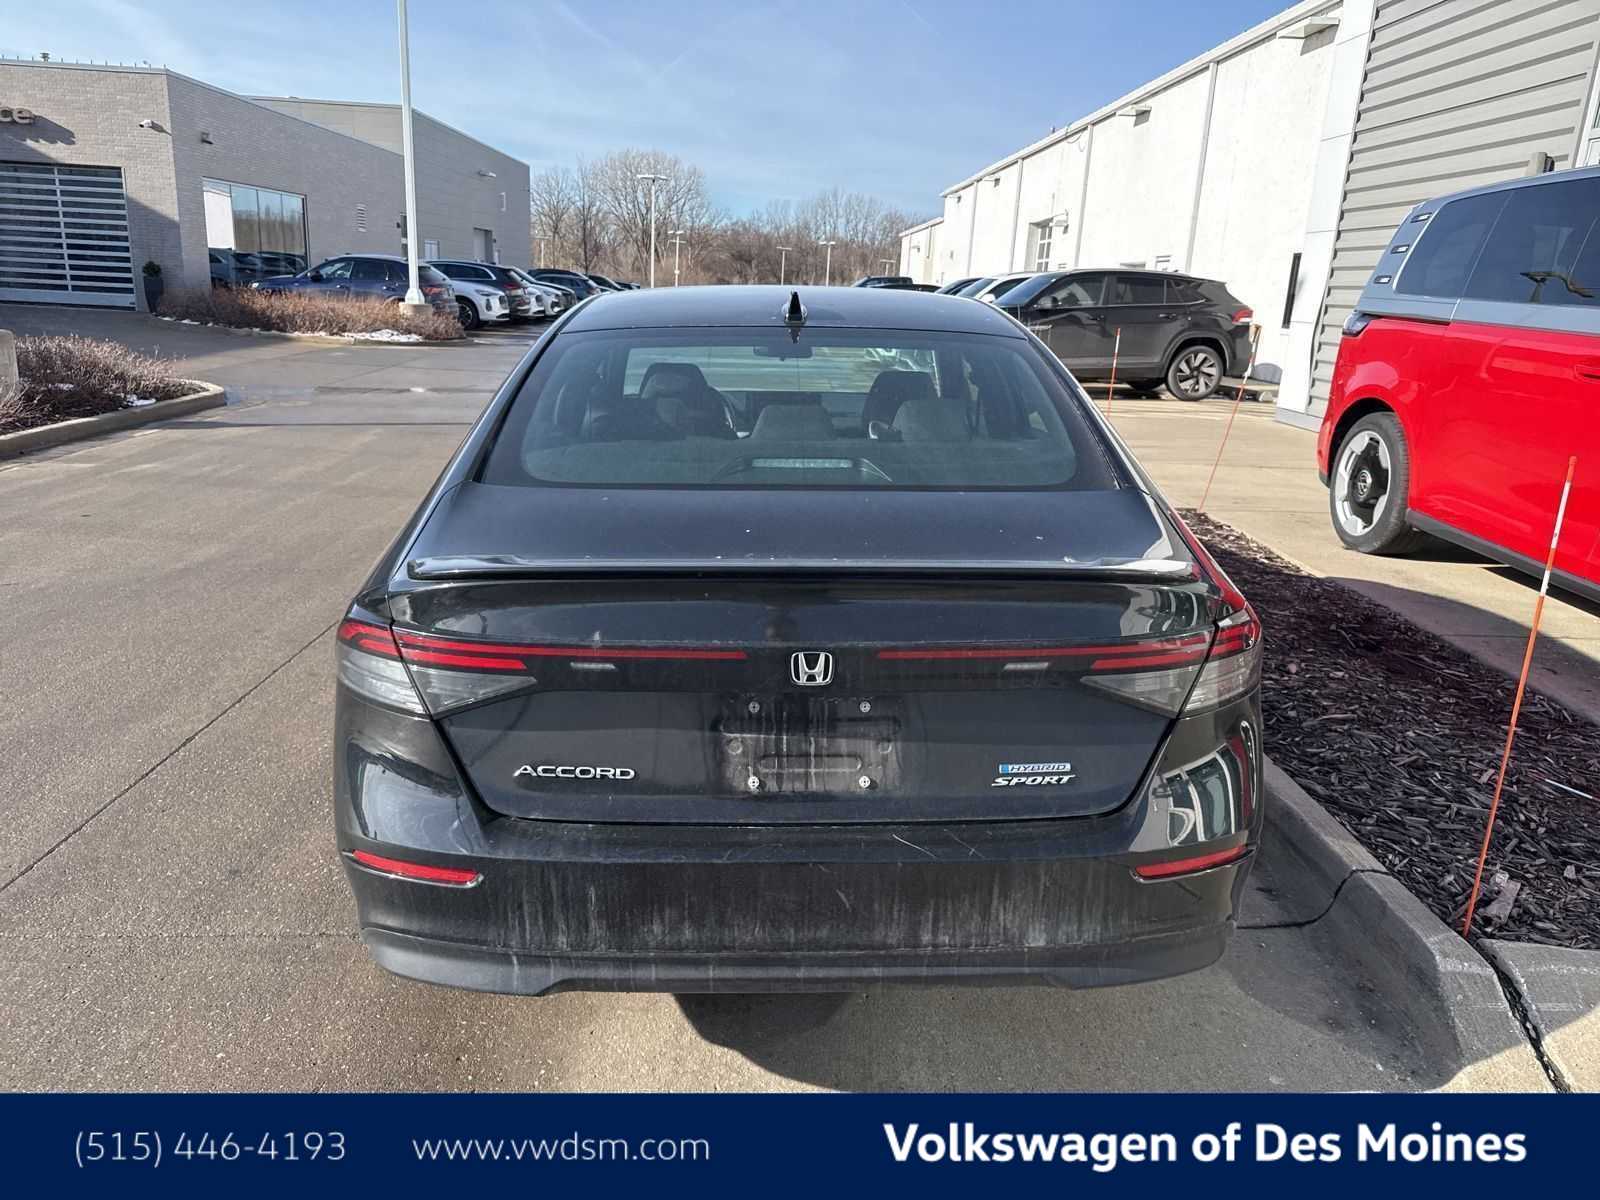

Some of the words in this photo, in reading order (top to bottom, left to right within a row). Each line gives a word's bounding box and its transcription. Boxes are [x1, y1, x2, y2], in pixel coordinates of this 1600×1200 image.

[512, 765, 636, 780] ACCORD
[1009, 762, 1069, 773] HYBRID
[991, 774, 1076, 787] SPORT
